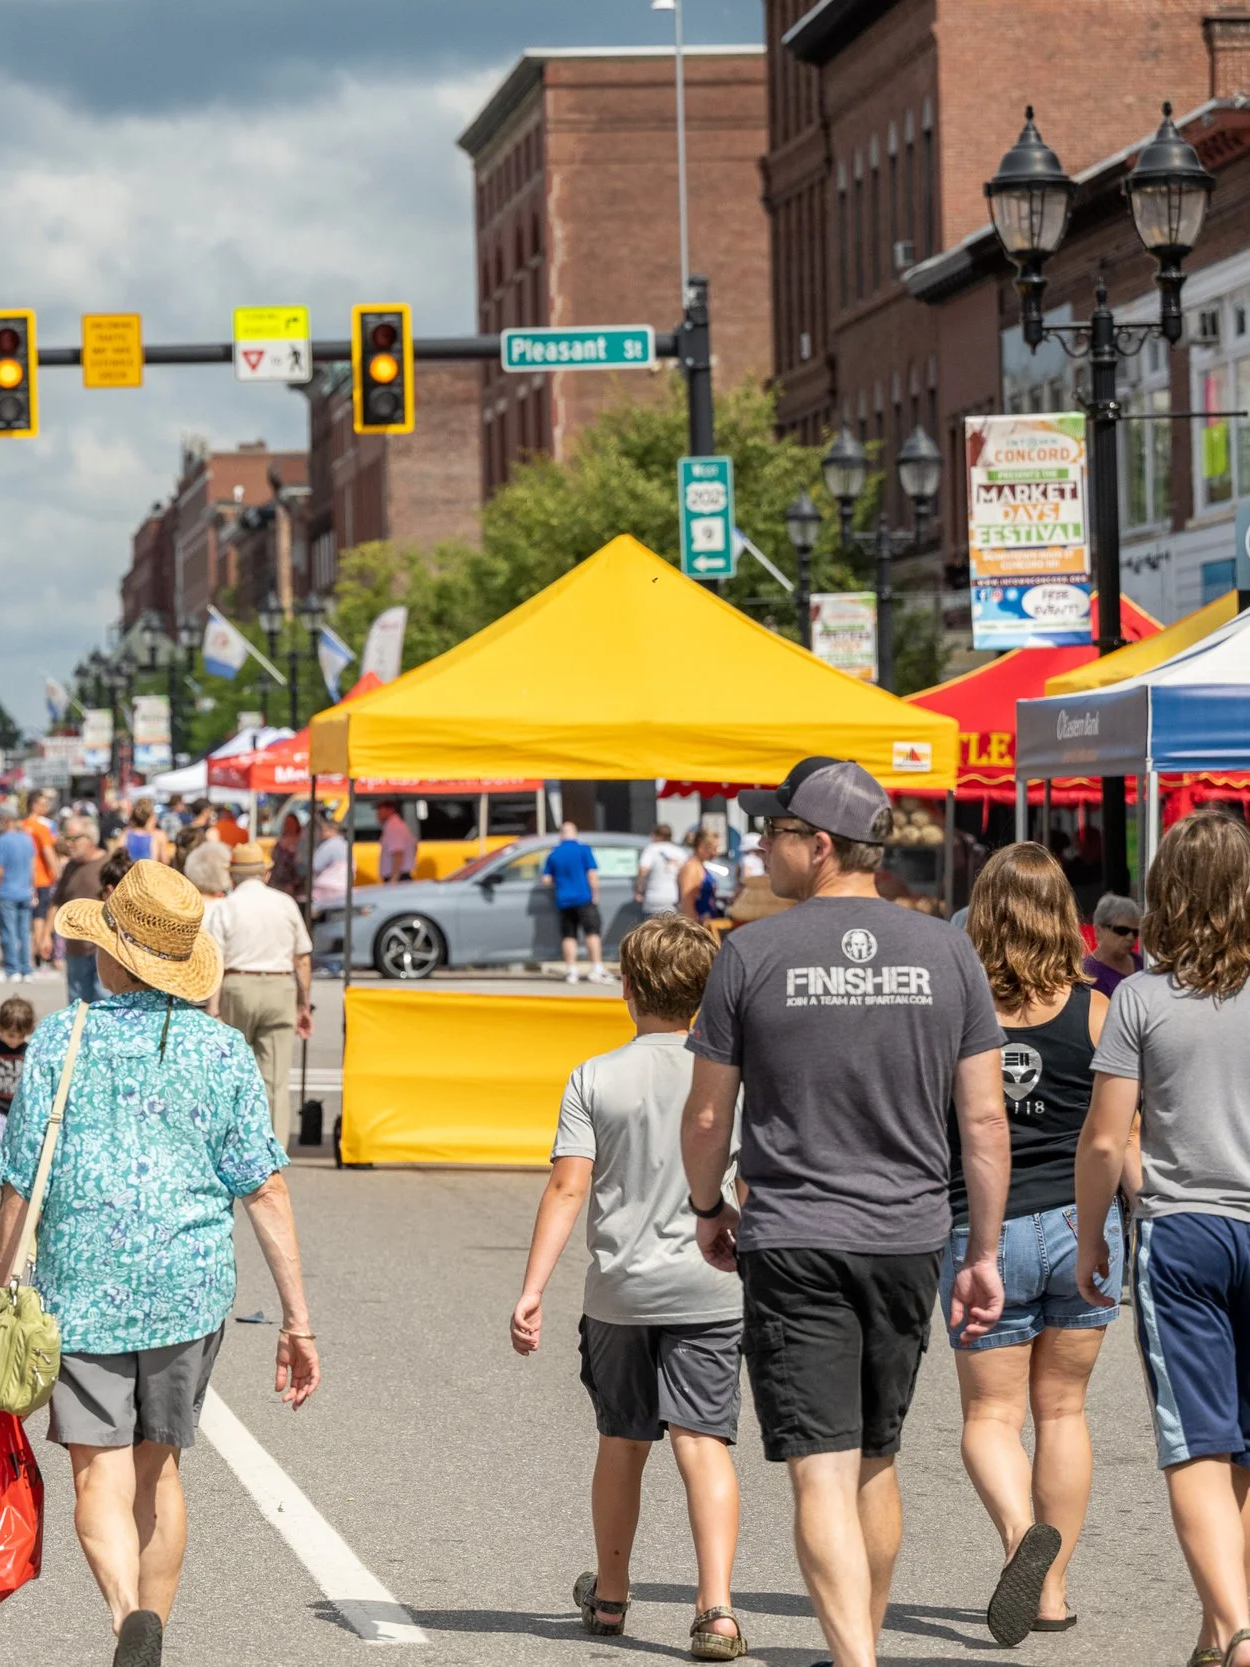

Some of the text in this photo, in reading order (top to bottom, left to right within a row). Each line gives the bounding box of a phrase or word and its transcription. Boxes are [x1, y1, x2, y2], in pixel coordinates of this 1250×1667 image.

[511, 335, 607, 363] Pleasant
[994, 448, 1070, 464] CONCORD
[690, 487, 723, 505] 202
[977, 482, 1075, 503] MARKET
[1000, 503, 1060, 521] DAYS
[702, 525, 714, 540] 9
[973, 523, 1081, 545] FESTIVAL
[786, 966, 932, 996] FINISHER
[786, 995, 933, 1007] JOIN A TEAM AT SPARTAN.COM
[1004, 1100, 1046, 1115] 118
